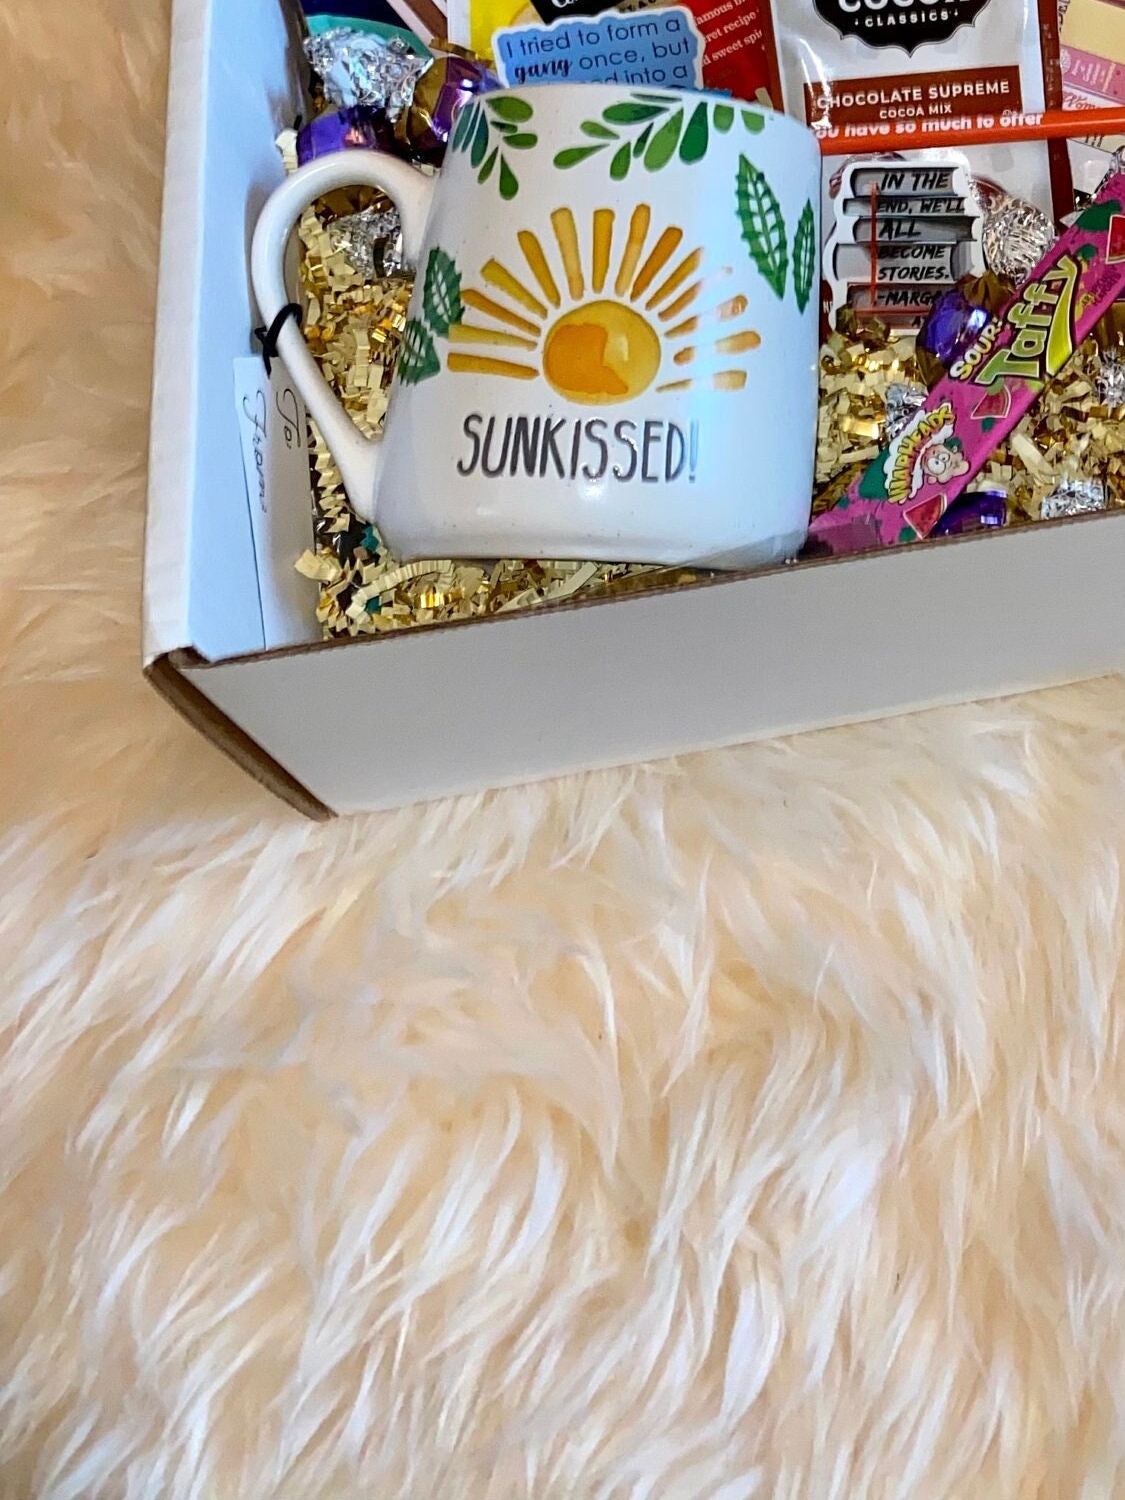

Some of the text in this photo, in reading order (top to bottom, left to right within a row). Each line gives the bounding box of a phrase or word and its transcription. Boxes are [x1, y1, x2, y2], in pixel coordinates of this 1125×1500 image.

[695, 1, 733, 27] amous
[865, 8, 949, 28] CLASSICS
[506, 18, 681, 58] I tried to form a
[514, 56, 573, 84] gang
[579, 48, 646, 71] once,
[651, 37, 690, 59] but
[711, 40, 743, 62] sweet
[624, 66, 666, 84] into
[672, 64, 688, 79] a
[817, 80, 1010, 109] CHOCOLATE SUPREME
[879, 103, 952, 119] COCOA MIX
[845, 122, 890, 138] have
[895, 119, 917, 135] so
[922, 114, 972, 132] much
[977, 113, 996, 129] to
[999, 110, 1043, 128] offer
[881, 173, 949, 190] IN THE
[876, 197, 965, 214] END, WE'LL
[878, 219, 921, 240] ALL
[877, 245, 946, 260] BECOME
[877, 266, 949, 281] STORIES.
[974, 254, 1078, 385] Taffy
[457, 413, 700, 485] SUNKISSED!
[888, 404, 955, 504] WARHEADS
